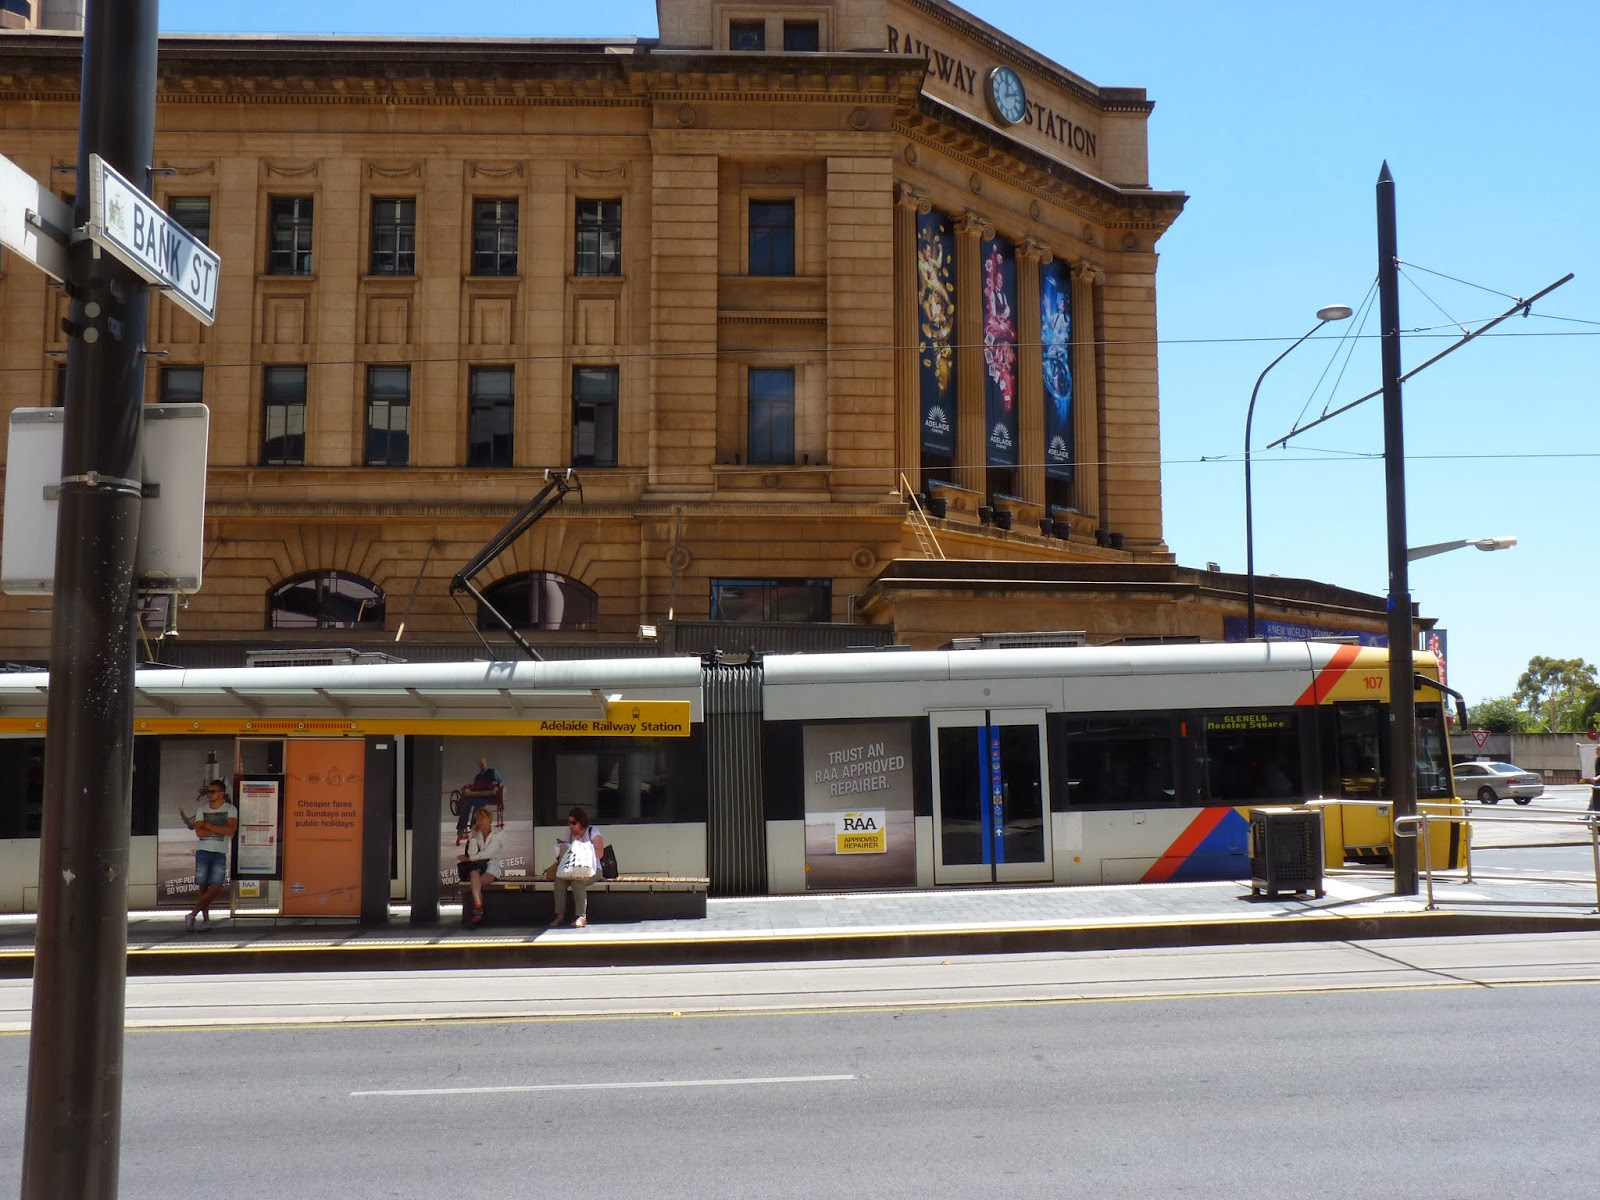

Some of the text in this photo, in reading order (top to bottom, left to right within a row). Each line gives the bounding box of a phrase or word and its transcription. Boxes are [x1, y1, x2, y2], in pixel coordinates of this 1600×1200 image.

[1025, 99, 1096, 158] STATION
[133, 202, 212, 302] BANK ST
[925, 419, 950, 432] ADELAIDE
[990, 435, 1012, 447] ADELAIDE
[1047, 448, 1069, 459] ADELAIDE
[1272, 625, 1286, 636] NEW
[1287, 627, 1306, 638] WORLD
[1363, 676, 1384, 690] 107
[1224, 714, 1268, 723] GLENELG
[540, 721, 682, 733] Adelaide Railway Station
[1207, 721, 1284, 730] Moseley Square
[828, 742, 885, 765] TRUST AN
[815, 755, 905, 784] RAA APPROVED
[830, 775, 890, 797] REPAIRER.
[297, 800, 352, 808] Cheaper fares
[305, 810, 339, 818] Sundays
[295, 820, 354, 828] public holidays
[843, 817, 877, 831] RAA
[506, 856, 526, 867] TEST,
[183, 876, 195, 884] PUT
[442, 877, 453, 885] YOU
[166, 887, 175, 895] SO
[176, 885, 188, 893] YOU
